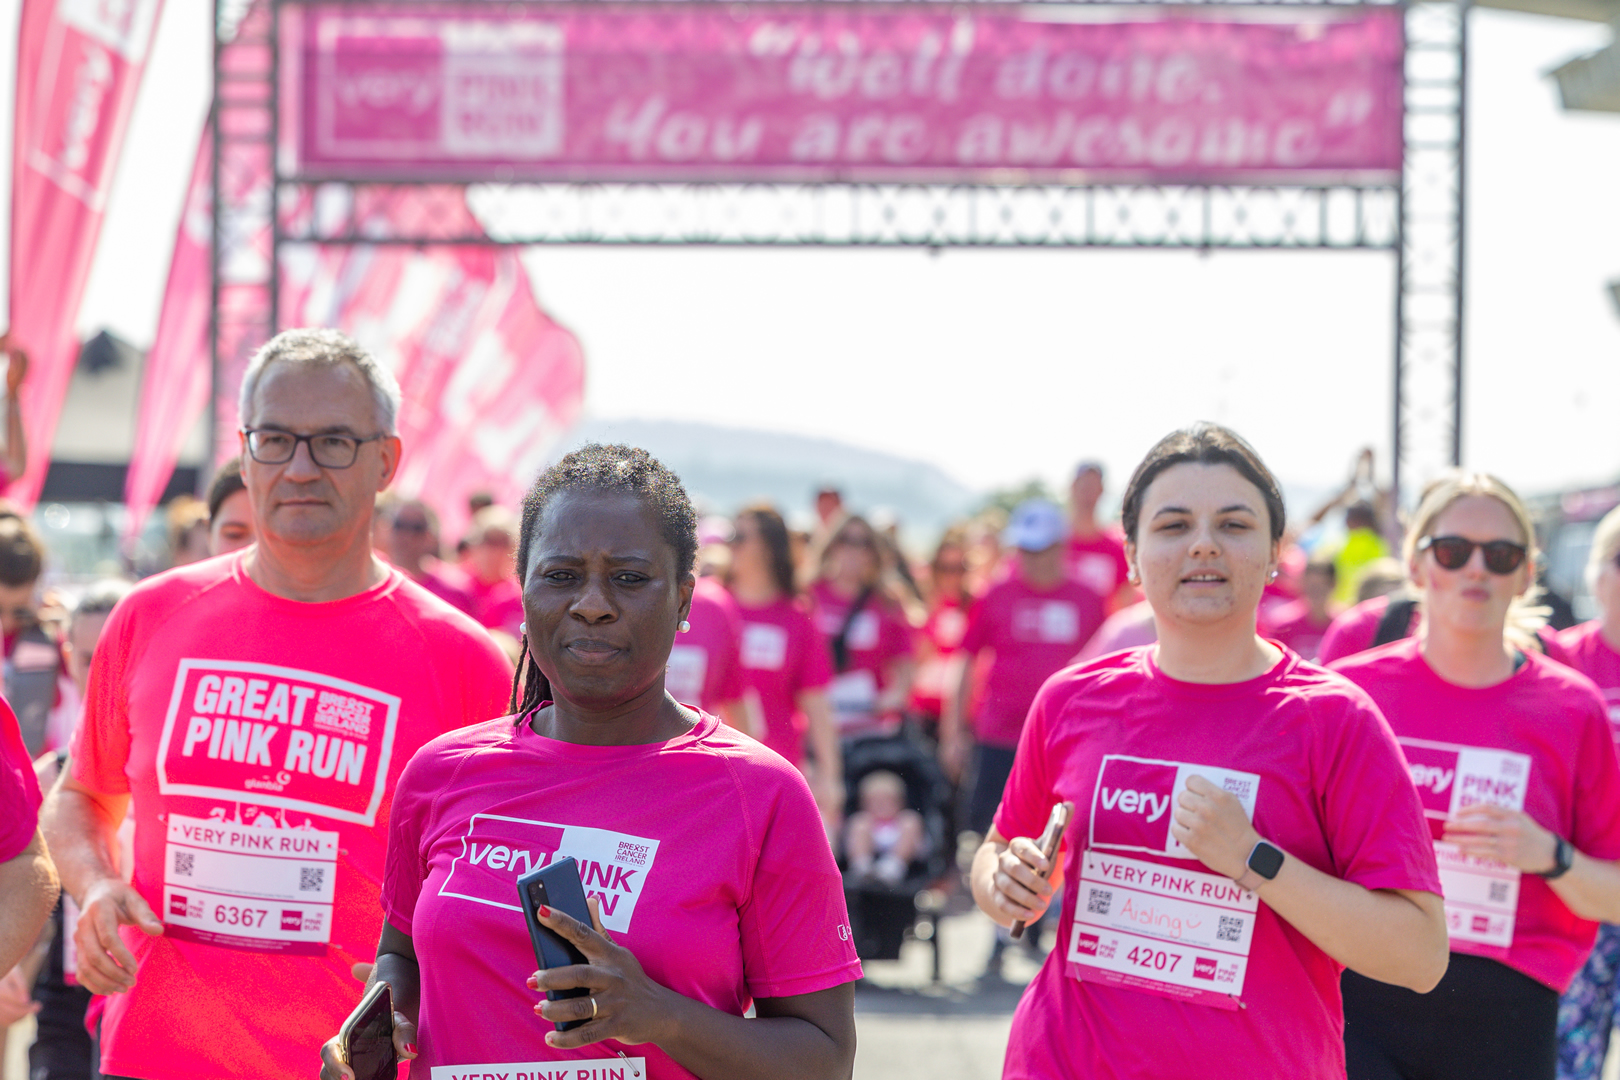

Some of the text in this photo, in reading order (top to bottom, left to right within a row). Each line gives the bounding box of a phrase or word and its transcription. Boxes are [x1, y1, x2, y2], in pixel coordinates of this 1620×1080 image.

[788, 110, 928, 163] are
[194, 675, 315, 726] GREAT
[317, 702, 371, 725] CANCER
[313, 711, 370, 735] IRELAND
[182, 716, 368, 786] PINK RUN
[1410, 763, 1454, 794] ery
[1463, 774, 1517, 800] PINK
[1101, 786, 1170, 823] very
[183, 825, 320, 853] VERY PINK RUN
[469, 842, 547, 876] very
[614, 855, 646, 866] IRELAND
[617, 849, 647, 860] CANCER
[562, 856, 639, 893] INK
[1101, 861, 1242, 903] VERY PINK RUN
[214, 904, 268, 929] 6367
[1127, 945, 1182, 973] 4207
